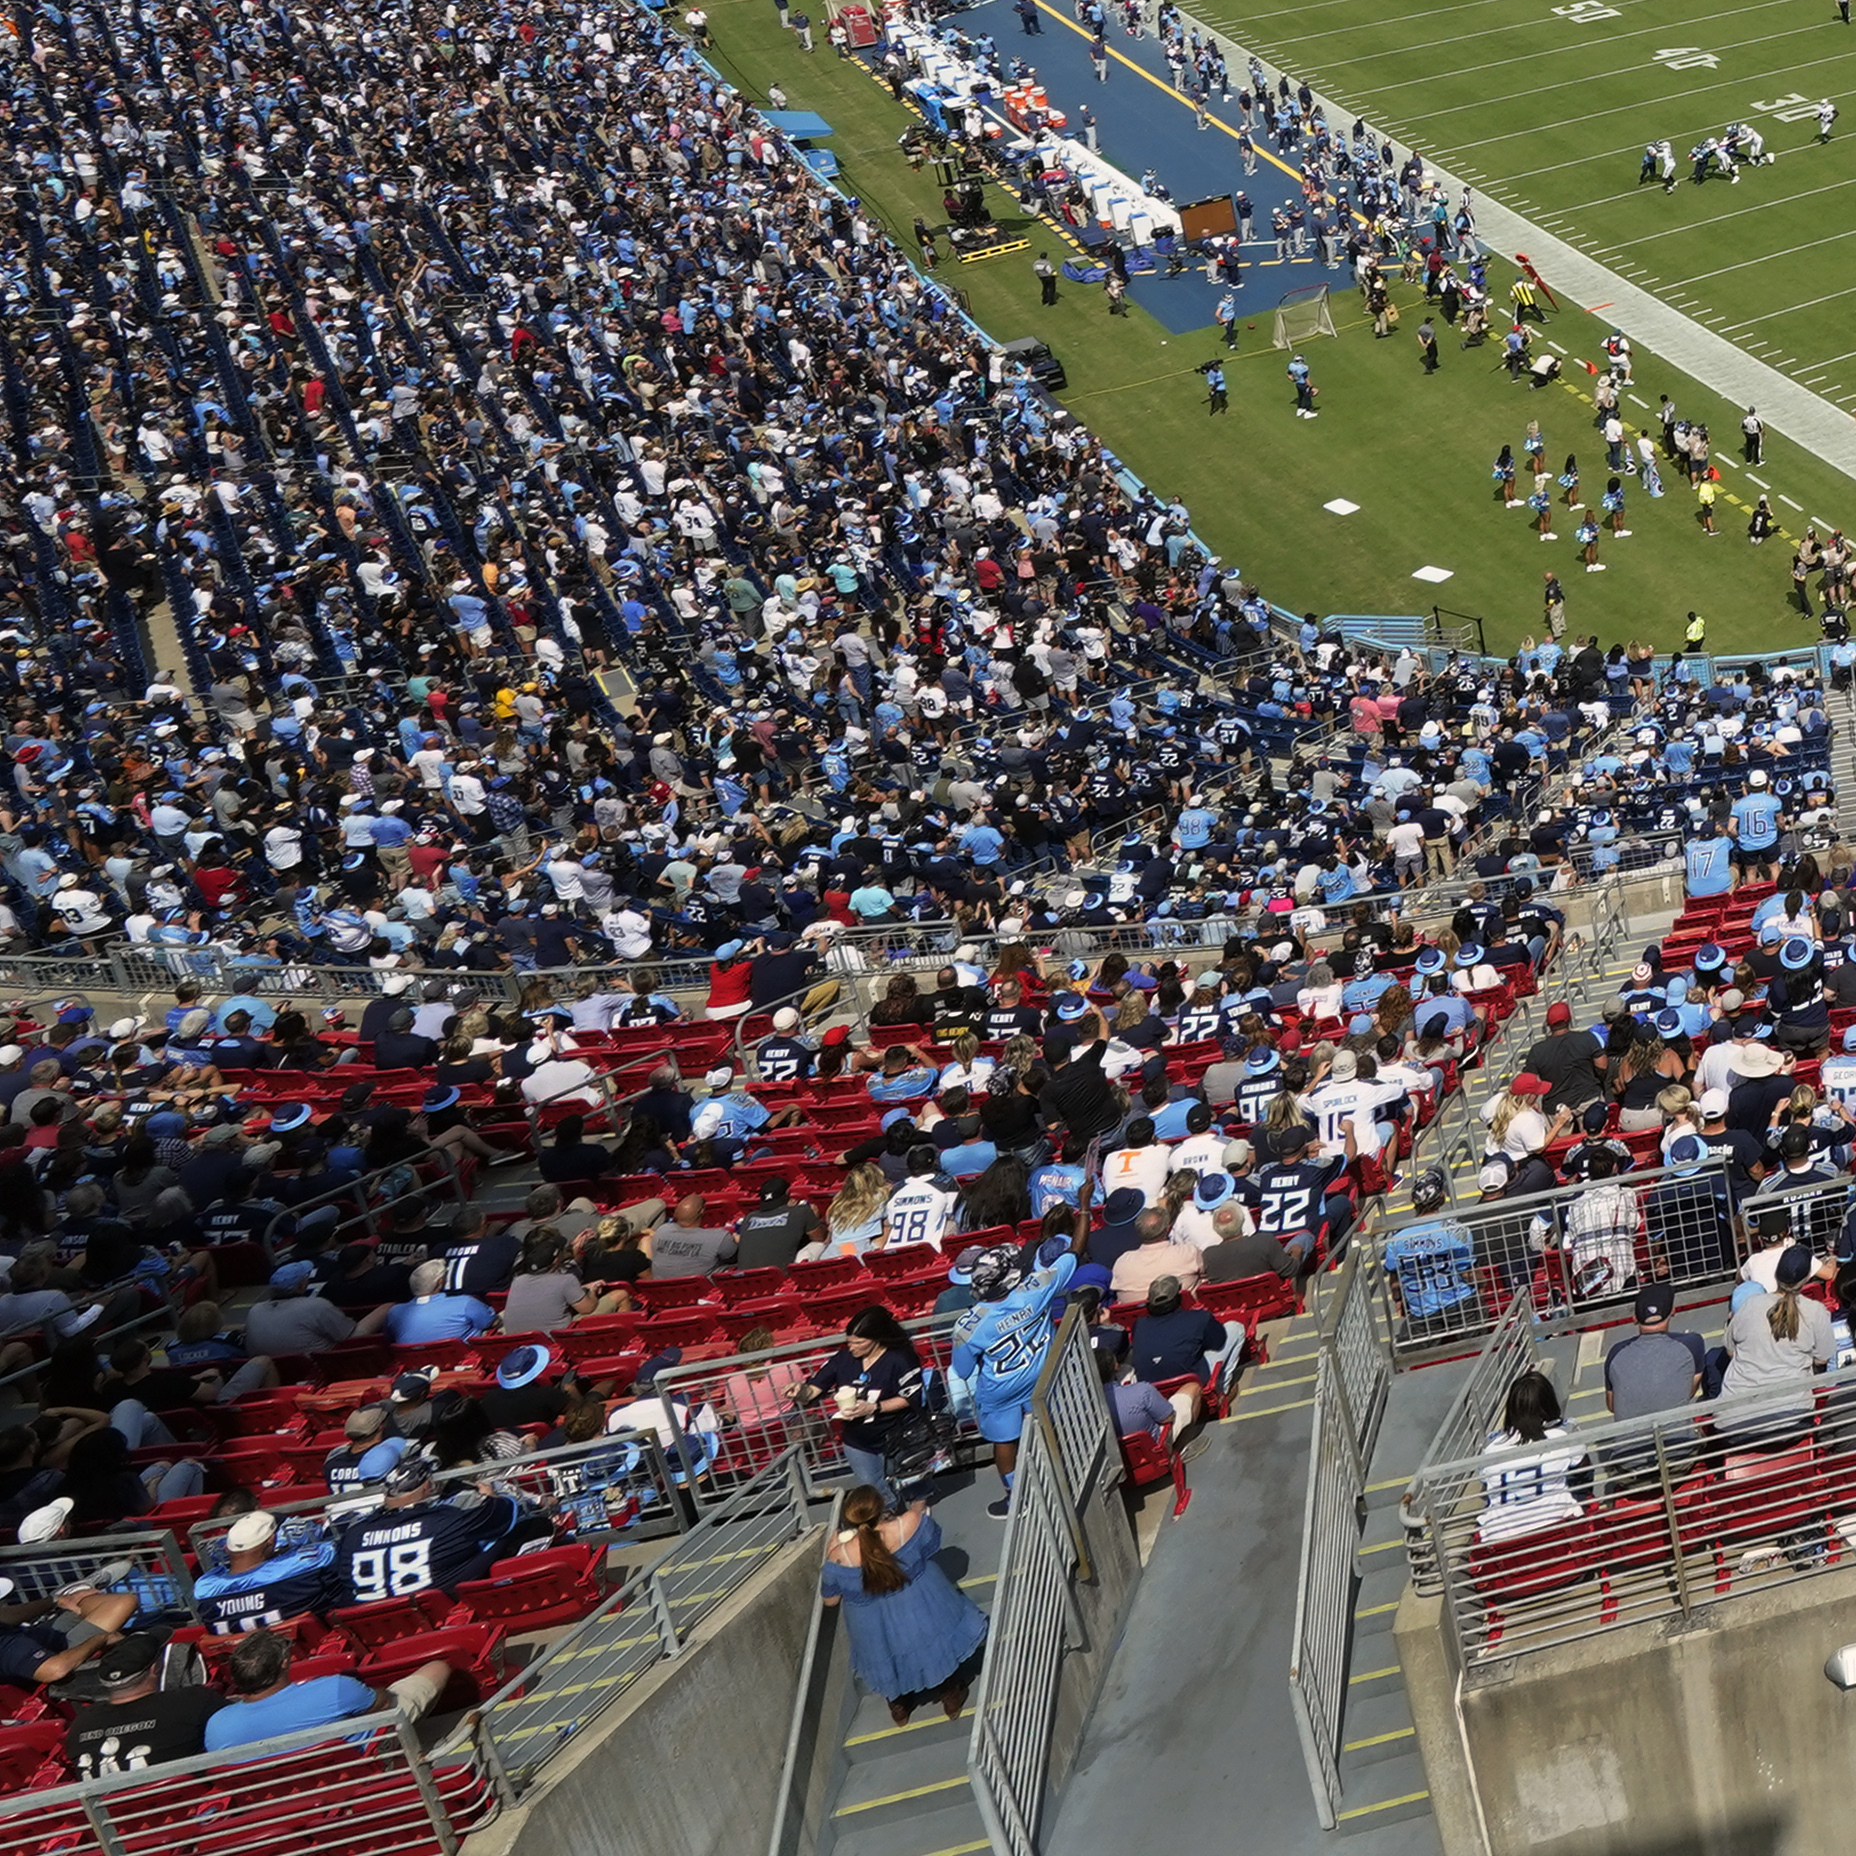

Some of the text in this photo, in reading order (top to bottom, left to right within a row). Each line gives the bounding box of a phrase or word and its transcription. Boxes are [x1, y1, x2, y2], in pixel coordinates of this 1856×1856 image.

[1549, 0, 1623, 24] 50
[1651, 46, 1722, 71] 40
[1743, 809, 1768, 838] 16
[1689, 848, 1718, 880] 17
[894, 1193, 934, 1209] SIMMONS
[1258, 1188, 1311, 1232] 22
[889, 1209, 932, 1244] 98
[995, 1305, 1035, 1332] HENRY
[985, 1312, 1051, 1378] 22
[361, 1521, 422, 1548] SIMMONS
[351, 1536, 435, 1603] 98
[215, 1591, 266, 1619] YOUNG
[106, 1719, 157, 1738] OREGON
